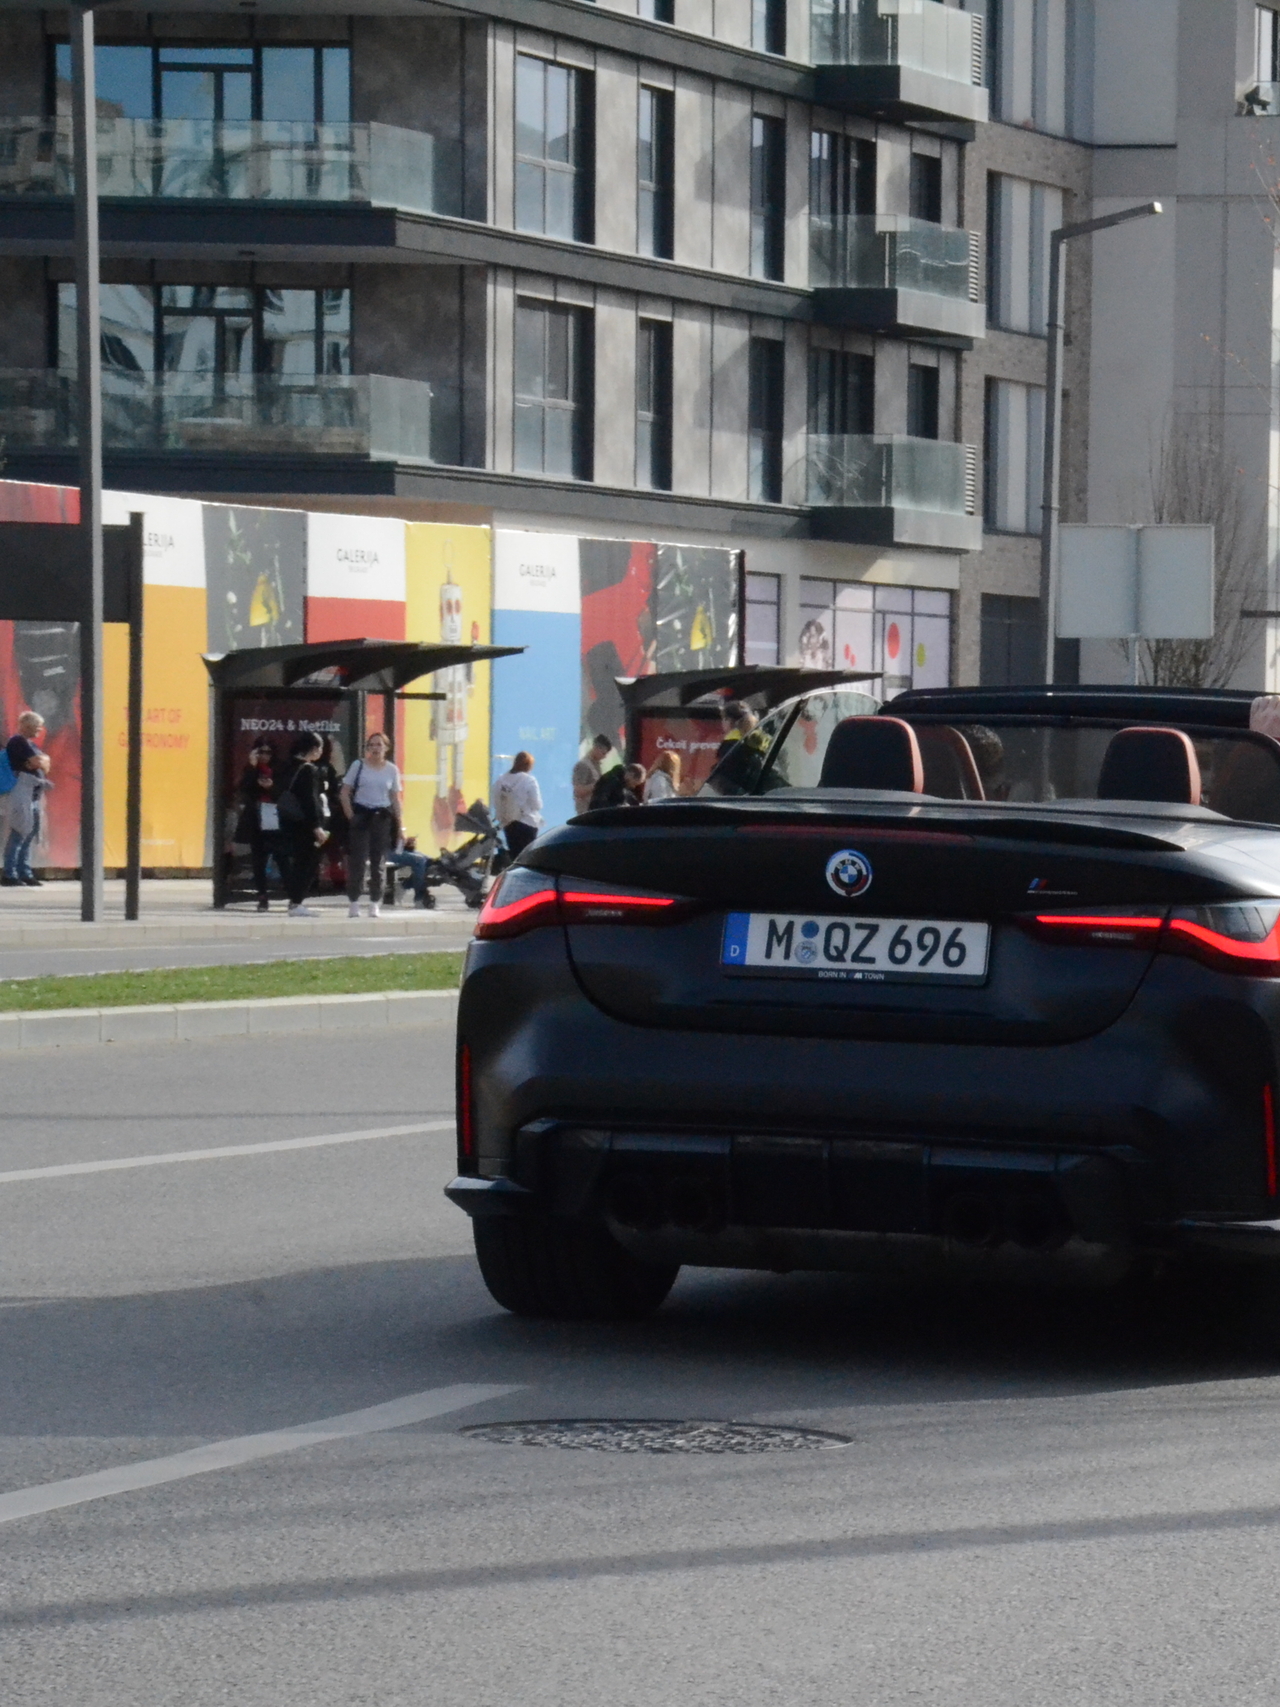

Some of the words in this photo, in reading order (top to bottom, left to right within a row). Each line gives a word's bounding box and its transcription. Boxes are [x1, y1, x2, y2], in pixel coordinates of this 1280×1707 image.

[336, 548, 380, 568] GALERIJA
[519, 563, 557, 581] GALERIJA
[298, 719, 340, 732] Netflix
[117, 732, 190, 749] GTRONOMY
[730, 945, 740, 957] D
[764, 918, 795, 960] M
[823, 922, 880, 964] QZ
[888, 924, 967, 968] 696
[818, 970, 838, 978] BORN
[864, 972, 885, 980] TOWN
